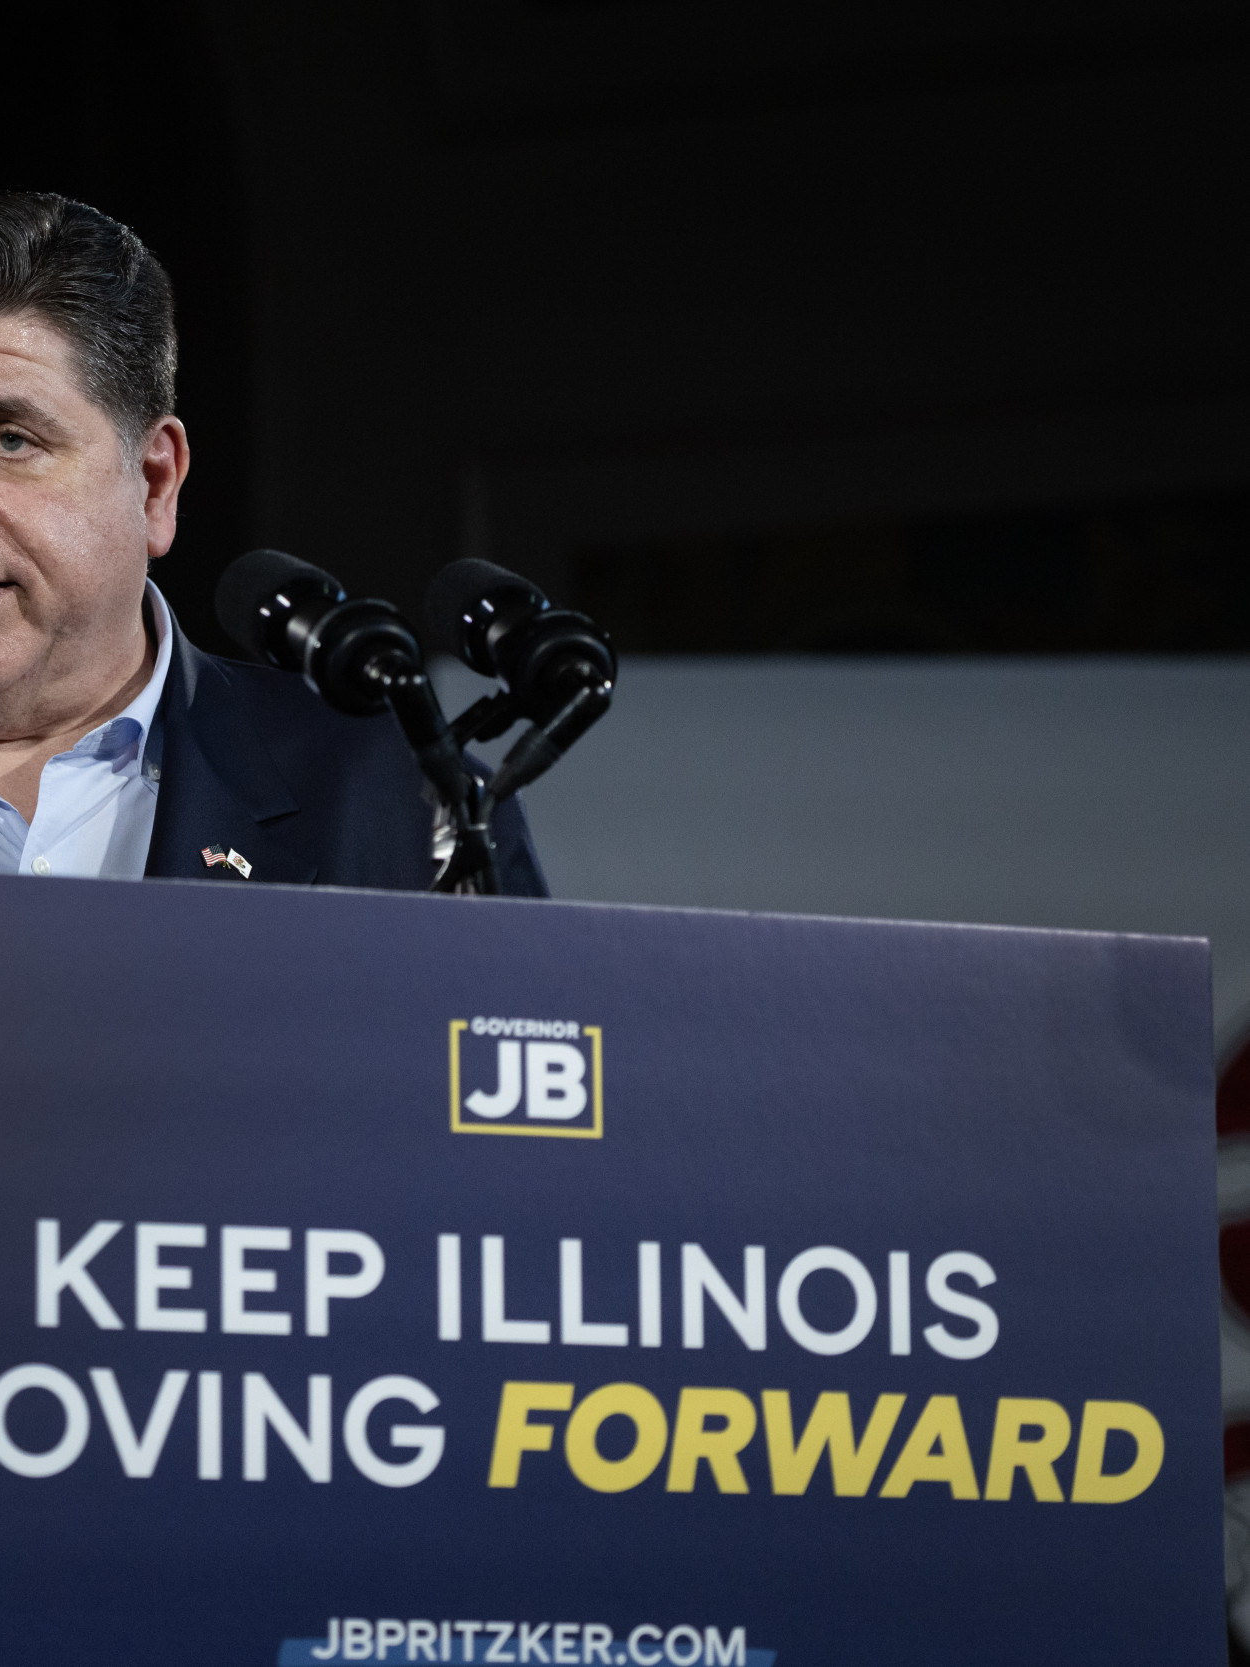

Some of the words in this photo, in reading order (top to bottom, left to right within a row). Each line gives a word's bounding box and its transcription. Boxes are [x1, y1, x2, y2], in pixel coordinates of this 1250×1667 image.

[470, 1015, 581, 1040] GOVERNOR
[464, 1039, 587, 1121] JB
[36, 1218, 385, 1337] KEEP
[438, 1233, 1000, 1361] ILLINOIS
[487, 1380, 1165, 1505] FORWARD
[310, 1617, 748, 1667] JBPRITZKER.COM
